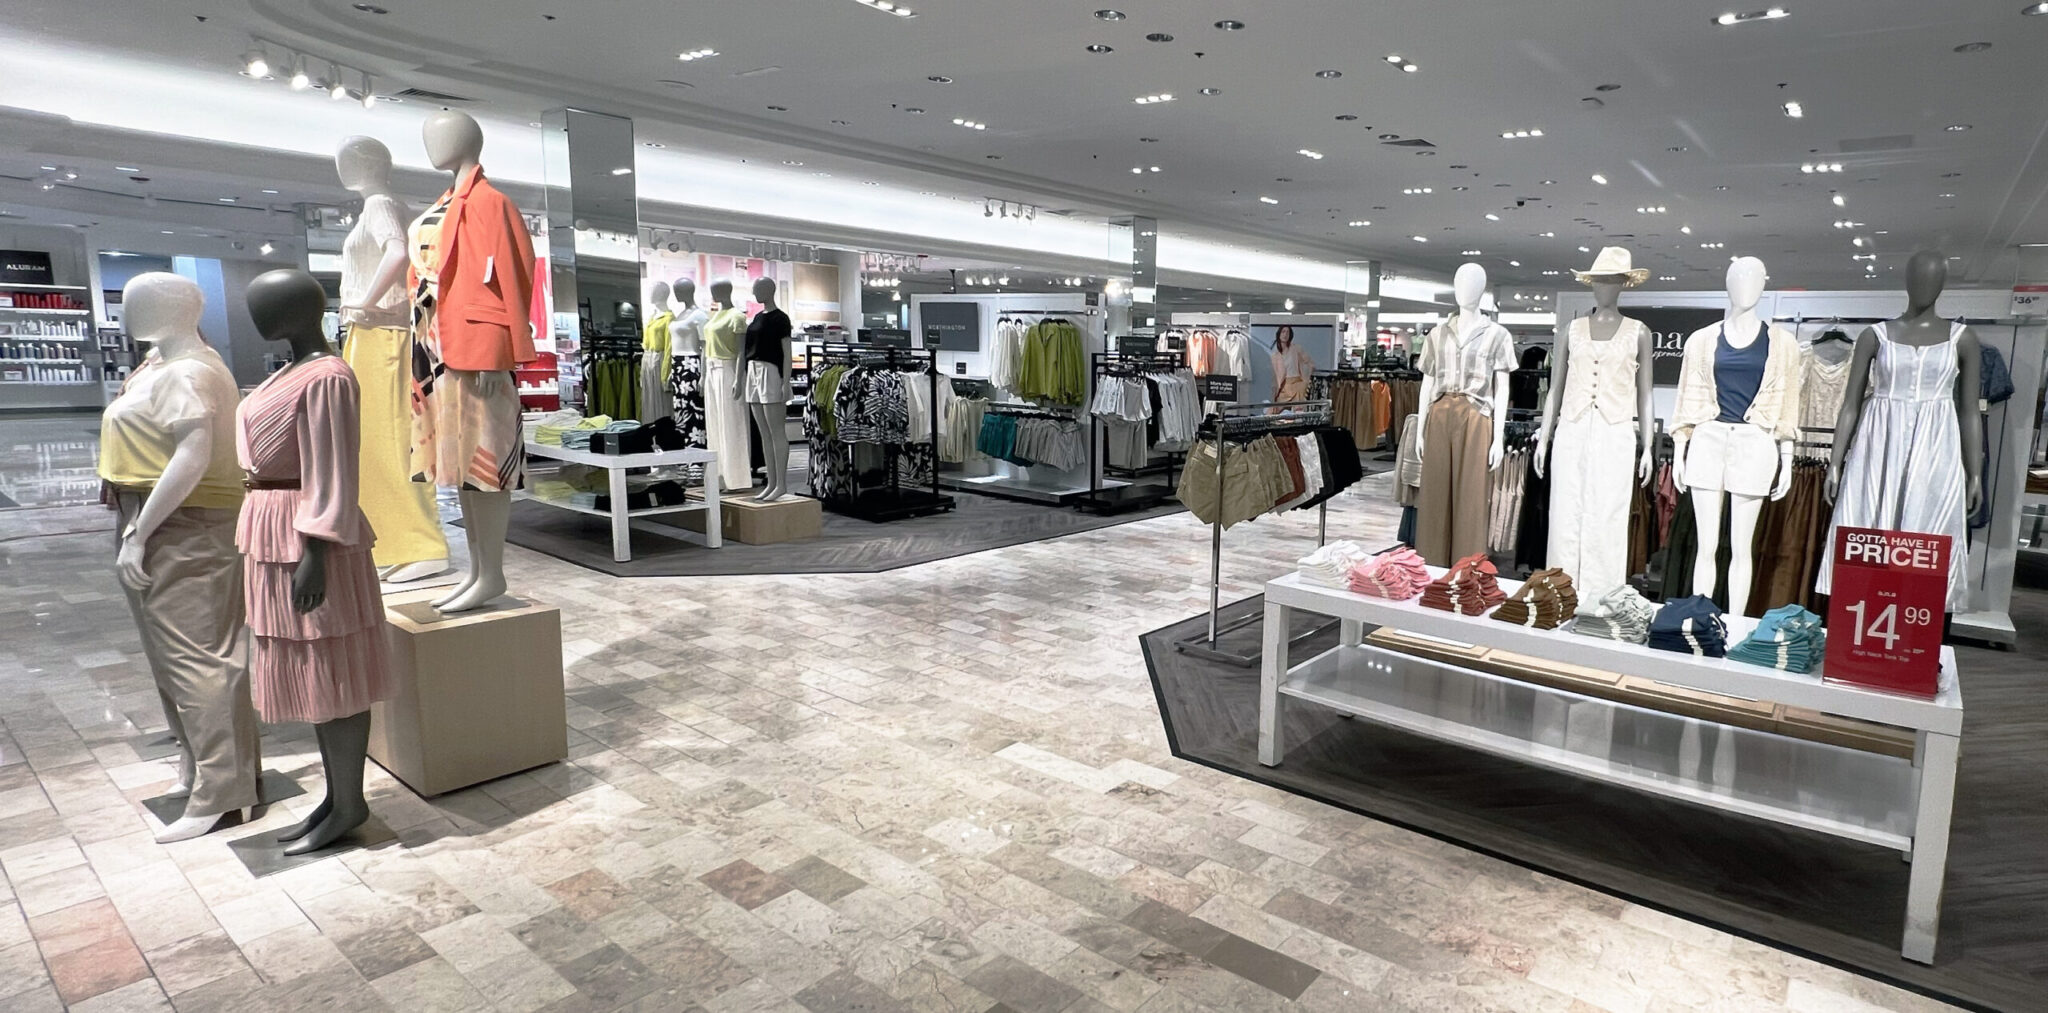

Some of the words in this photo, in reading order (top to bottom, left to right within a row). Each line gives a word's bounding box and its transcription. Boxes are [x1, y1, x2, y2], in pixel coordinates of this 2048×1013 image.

[1845, 541, 1939, 570] PRICE!
[1847, 532, 1888, 545] GOTTA
[1891, 537, 1924, 549] HAVE
[1928, 540, 1939, 550] IT
[1845, 600, 1901, 650] 14
[1904, 606, 1931, 626] 99
